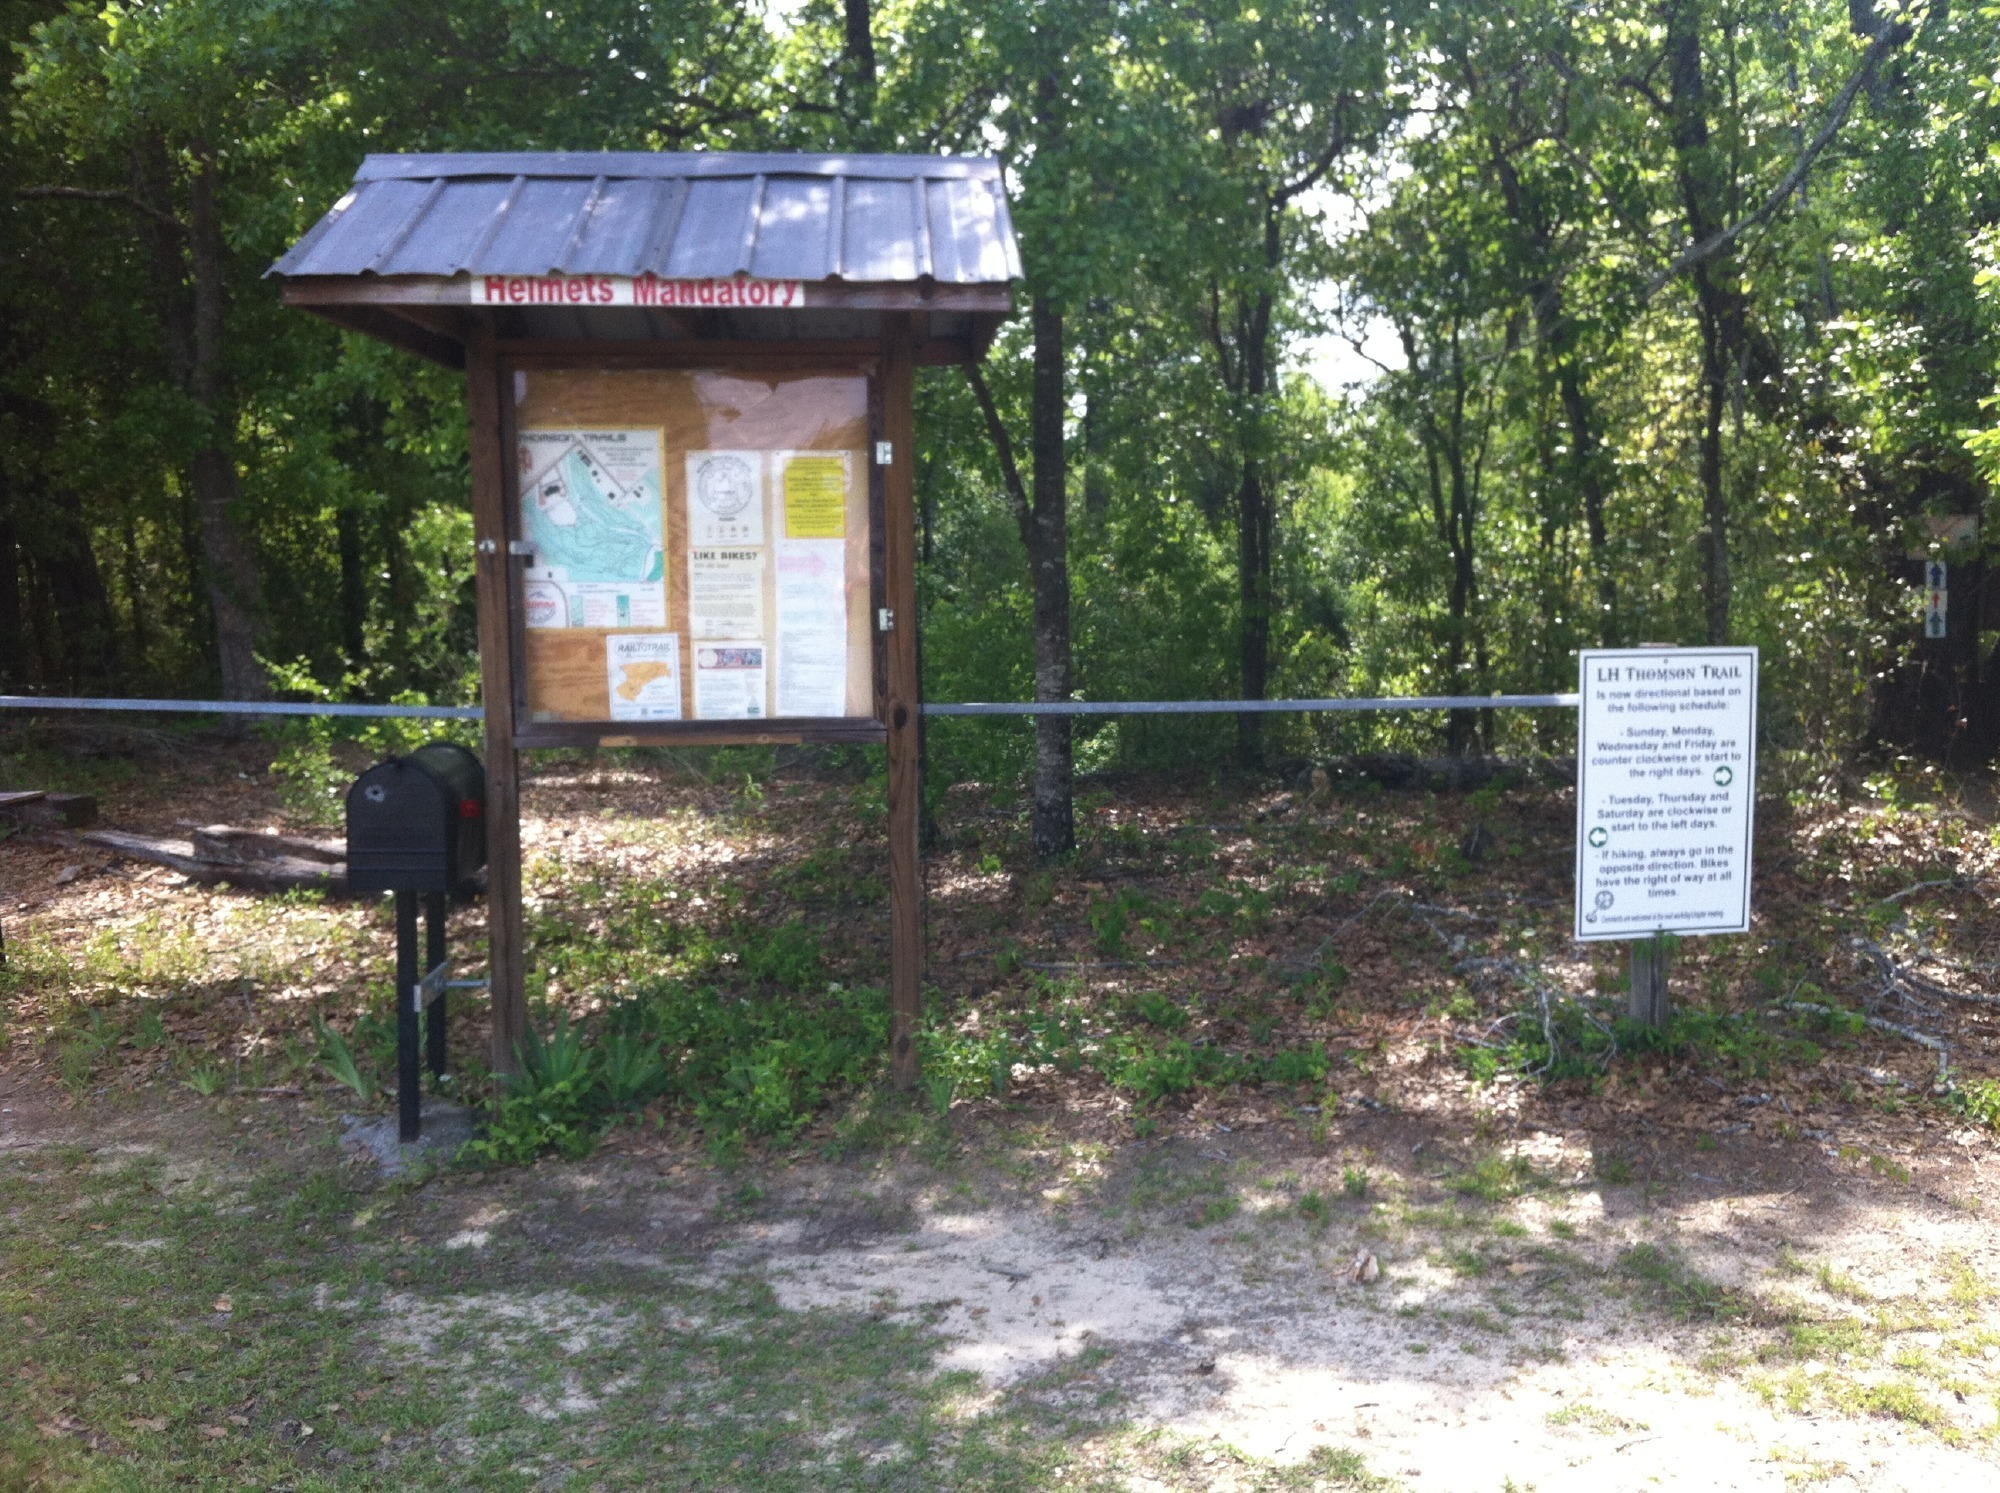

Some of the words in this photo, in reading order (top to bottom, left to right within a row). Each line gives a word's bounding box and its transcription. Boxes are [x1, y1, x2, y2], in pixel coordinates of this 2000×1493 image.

[485, 275, 614, 303] Helmets
[633, 274, 796, 306] Mandatory
[693, 551, 716, 560] LIKE
[720, 551, 757, 560] BIKES?
[1597, 667, 1619, 682] LH
[1626, 666, 1696, 681] THOMSON
[1701, 664, 1742, 679] TRAIL
[1635, 687, 1690, 698] directional
[1694, 686, 1725, 696] based
[1728, 687, 1741, 695] on
[1608, 704, 1624, 713] the
[1627, 702, 1676, 713] following
[1672, 726, 1714, 737] Monday,
[1598, 741, 1658, 752] Wednesday
[1662, 740, 1681, 749] and
[1685, 739, 1717, 750] Friday
[1720, 740, 1736, 748] are
[1592, 756, 1631, 765] counter
[1636, 753, 1687, 764] clockwise
[1705, 753, 1728, 762] start
[1731, 752, 1741, 761] to
[1630, 768, 1645, 778] the
[1649, 767, 1673, 779] right
[1677, 767, 1704, 779] days.
[1658, 793, 1706, 803] Thursday
[1710, 792, 1729, 801] and
[1597, 809, 1644, 820] Saturday
[1648, 809, 1663, 817] are
[1668, 806, 1718, 816] clockwise
[1611, 822, 1635, 832] start
[1638, 822, 1648, 831] to
[1652, 821, 1668, 830] the
[1671, 820, 1687, 829] left
[1690, 819, 1717, 830] days.
[1602, 851, 1609, 859] If
[1612, 850, 1646, 860] hiking,
[1650, 849, 1685, 858] always
[1689, 848, 1701, 856] go
[1718, 846, 1734, 854] the
[1599, 864, 1644, 874] opposite
[1648, 862, 1696, 871] direction.
[1700, 858, 1729, 868] Bikes
[1596, 878, 1620, 887] have
[1624, 876, 1640, 885] the
[1643, 874, 1668, 887] right
[1670, 874, 1681, 883] of
[1684, 874, 1704, 884] way
[1707, 872, 1717, 881] at
[1720, 872, 1731, 880] all
[1648, 888, 1678, 898] times.
